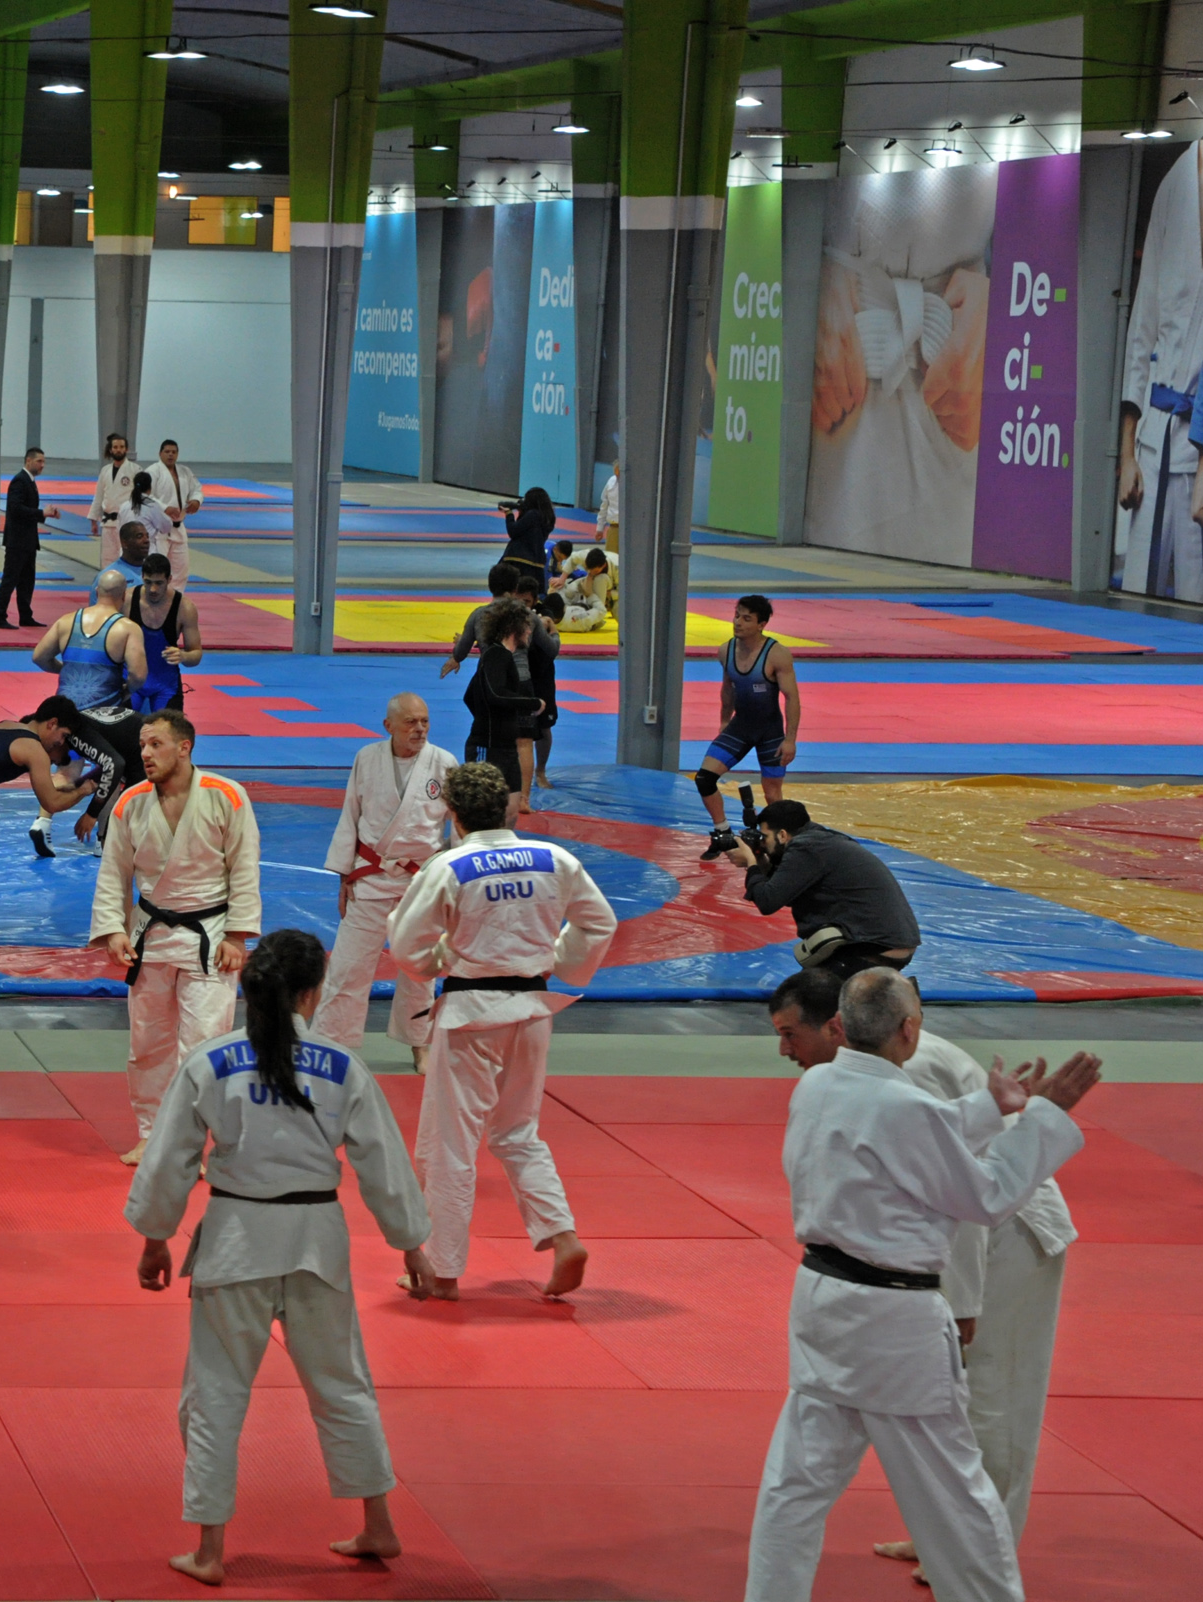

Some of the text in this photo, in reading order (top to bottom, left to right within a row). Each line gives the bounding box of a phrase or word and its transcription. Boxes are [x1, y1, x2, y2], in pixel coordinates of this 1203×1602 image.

[733, 271, 783, 319] Crec
[1009, 261, 1067, 317] De-
[360, 299, 398, 332] camino
[400, 307, 413, 333] es
[353, 350, 418, 383] recompensa
[728, 331, 781, 382] mien
[377, 410, 420, 432] #JugamosTodo
[998, 404, 1069, 469] sión.
[96, 752, 115, 799] CARLSON
[485, 880, 534, 902] URU
